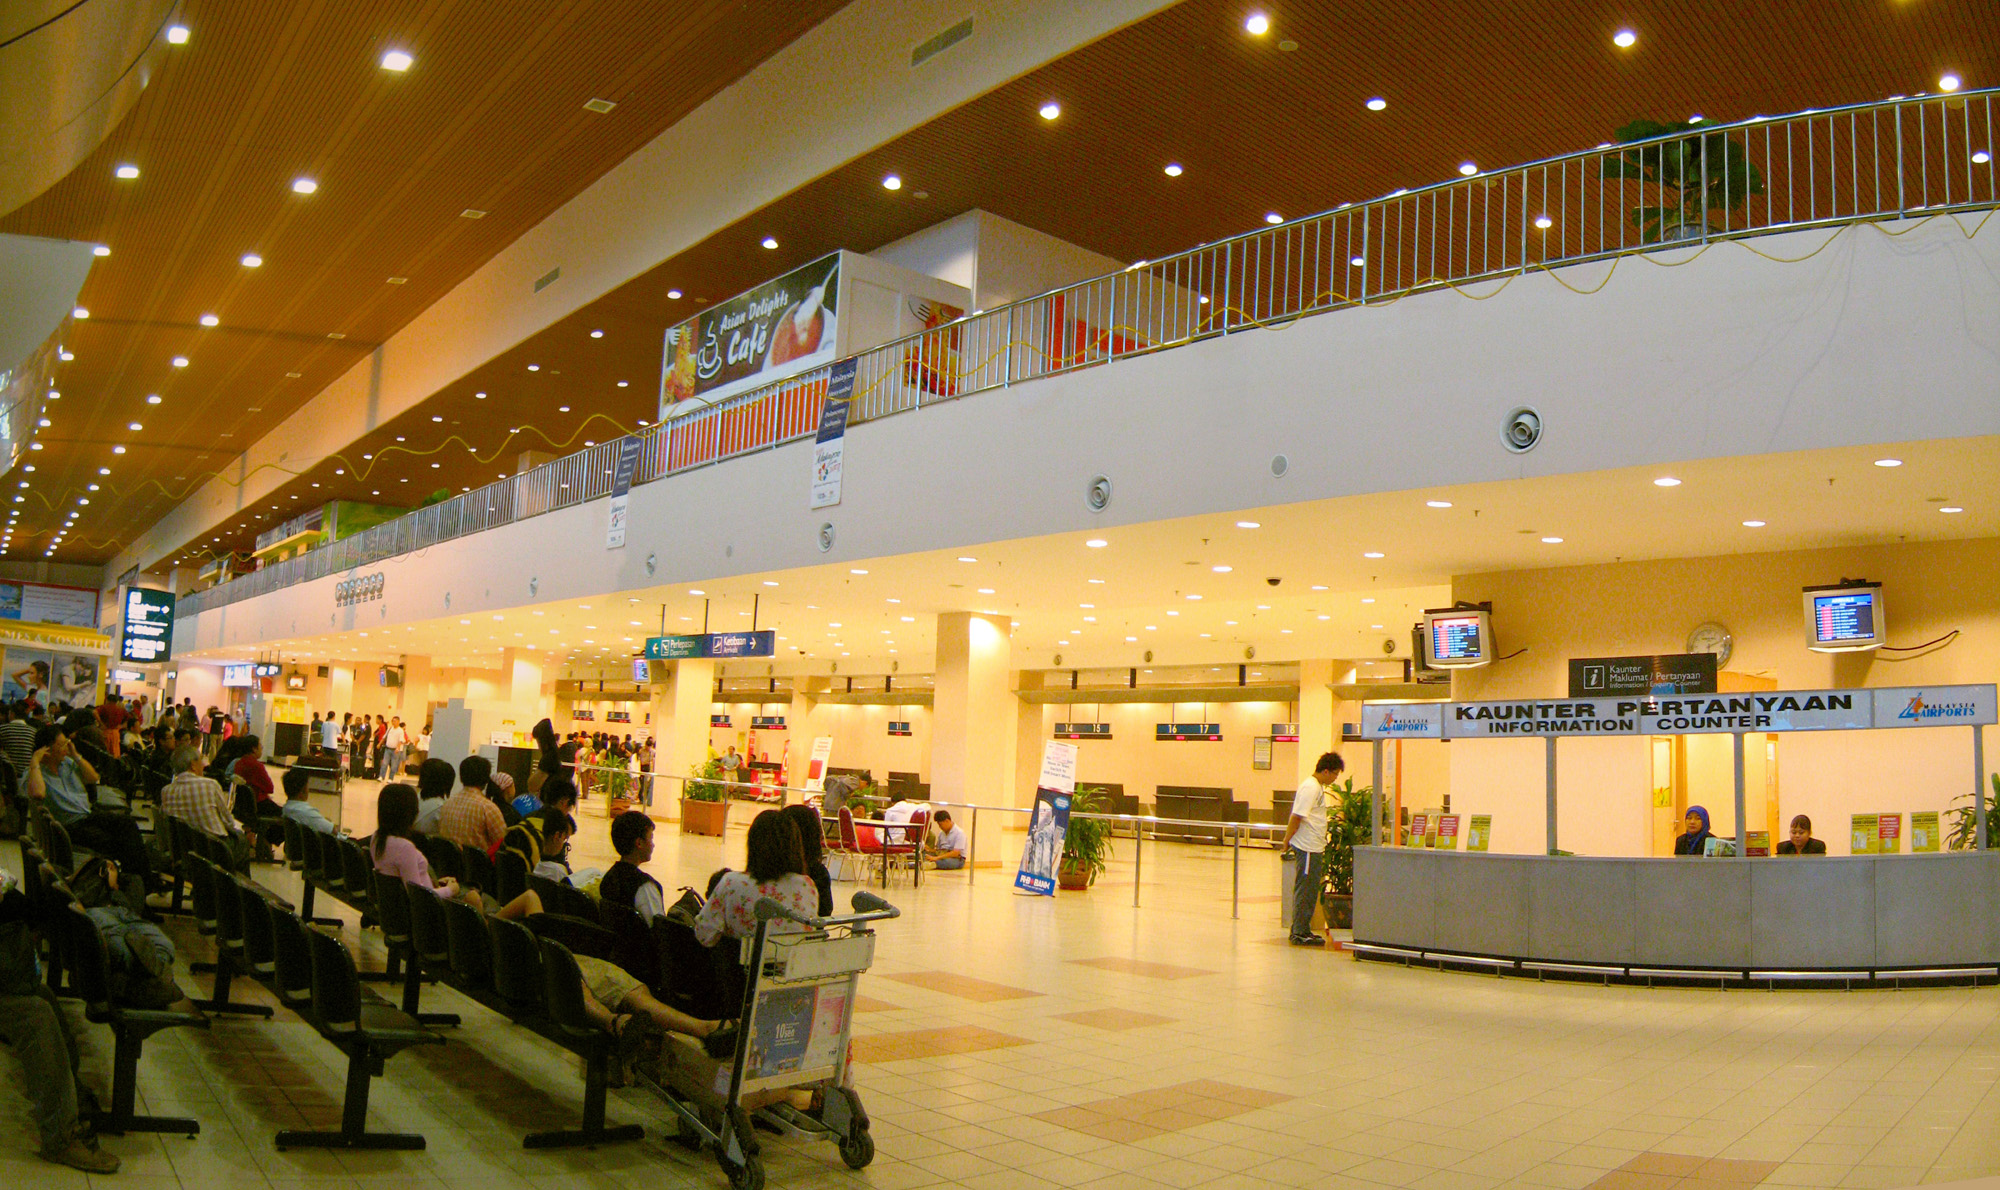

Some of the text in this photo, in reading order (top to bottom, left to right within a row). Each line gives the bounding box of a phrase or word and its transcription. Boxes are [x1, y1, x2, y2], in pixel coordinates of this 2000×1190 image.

[720, 290, 789, 335] Asian Delights
[1610, 666, 1642, 674] Kaunter
[1610, 674, 1648, 682] Maklumat
[1656, 672, 1701, 681] Pertanyaan
[1456, 695, 1852, 720] KAUNTER PERTANYAAN
[1920, 708, 1975, 718] AIRPORTS
[1065, 724, 1073, 732] 14
[1093, 724, 1101, 732] 15
[1392, 723, 1428, 731] AIRPORTS
[1489, 715, 1771, 733] INFORMATION COUNTER
[1168, 725, 1177, 734] 16
[1200, 725, 1209, 734] 17
[1285, 725, 1296, 734] 18
